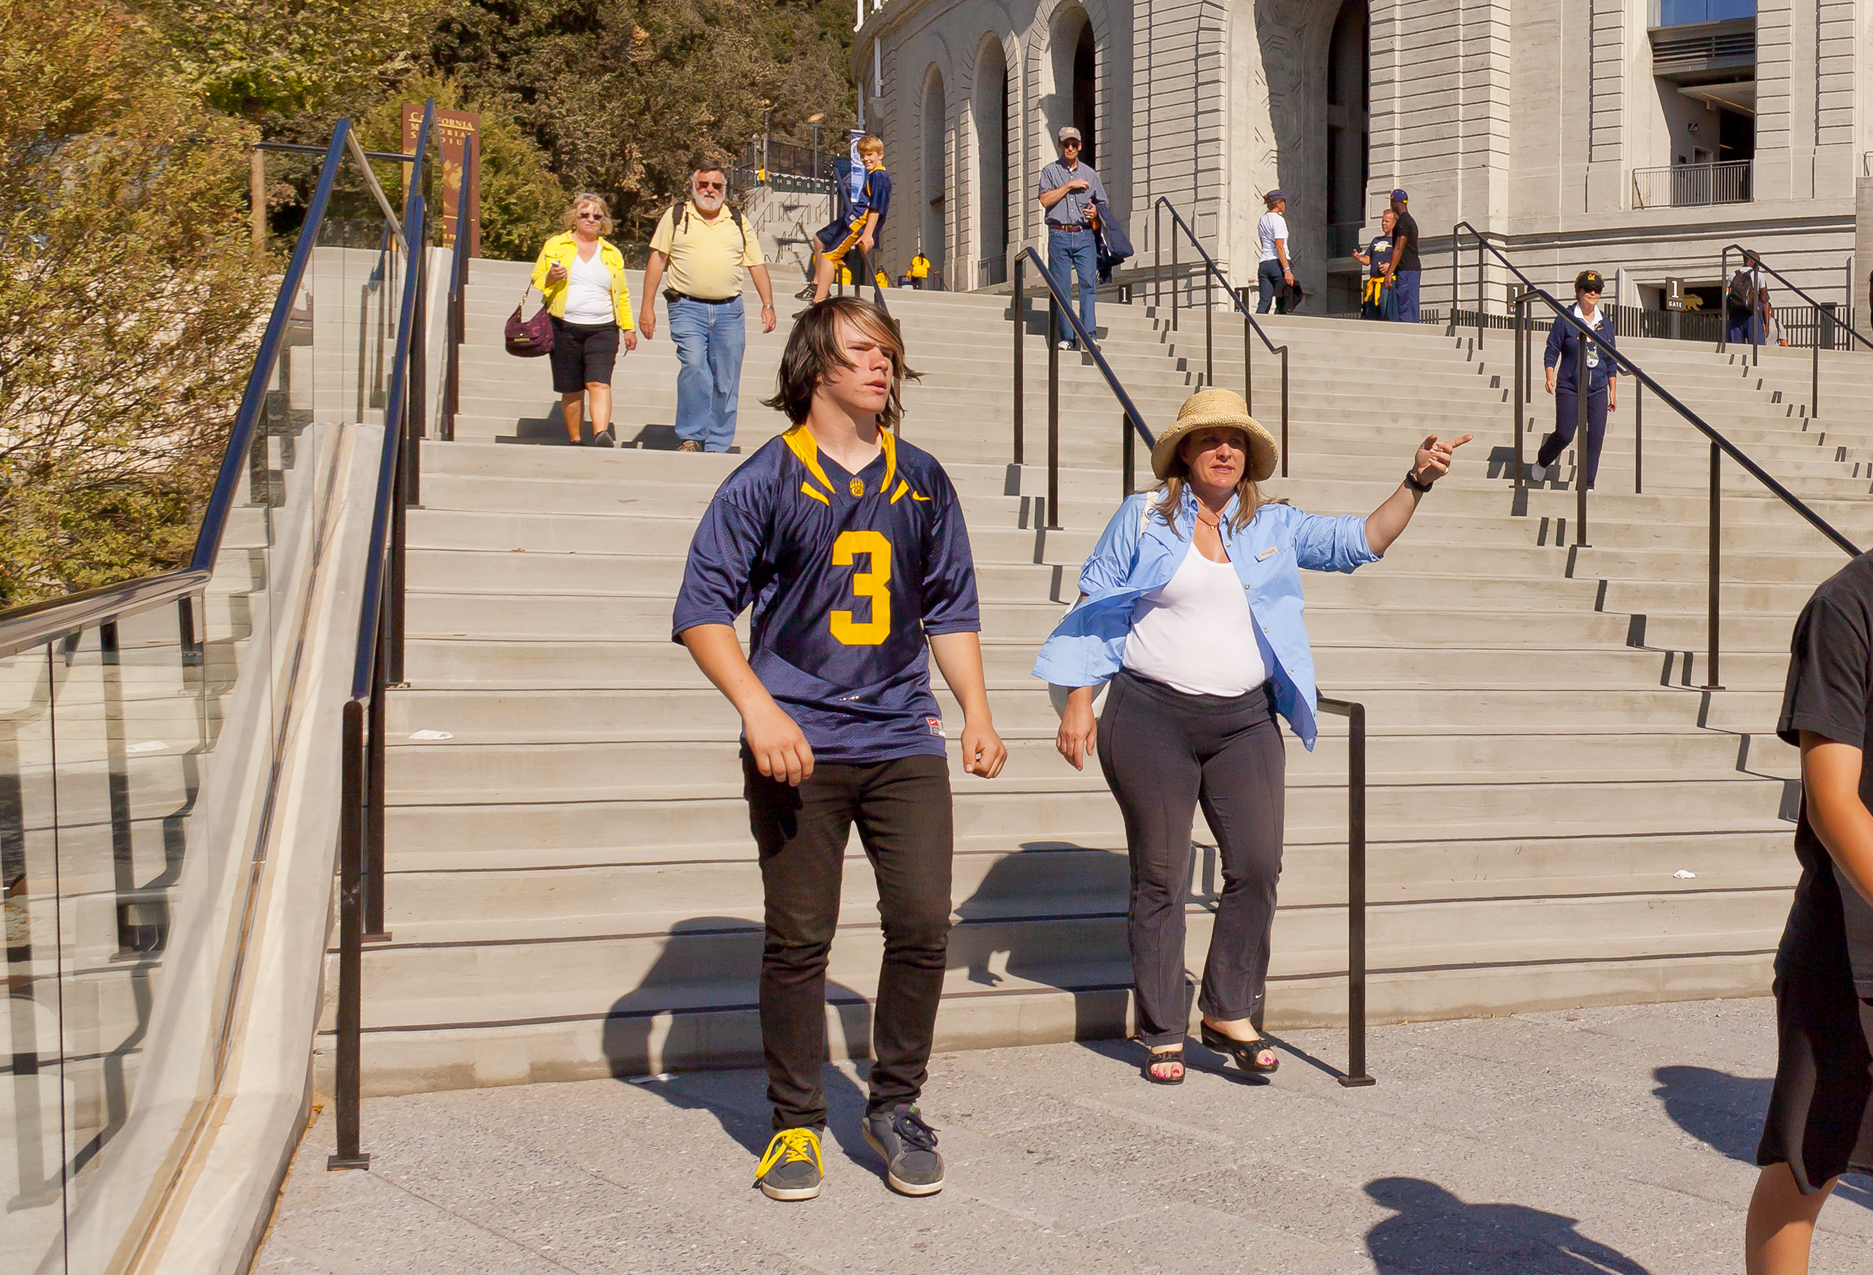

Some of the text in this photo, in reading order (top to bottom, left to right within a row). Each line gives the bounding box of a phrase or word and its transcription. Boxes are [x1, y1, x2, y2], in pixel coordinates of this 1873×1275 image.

[1120, 286, 1129, 303] 1
[1671, 280, 1680, 298] 1
[830, 531, 892, 645] 3
